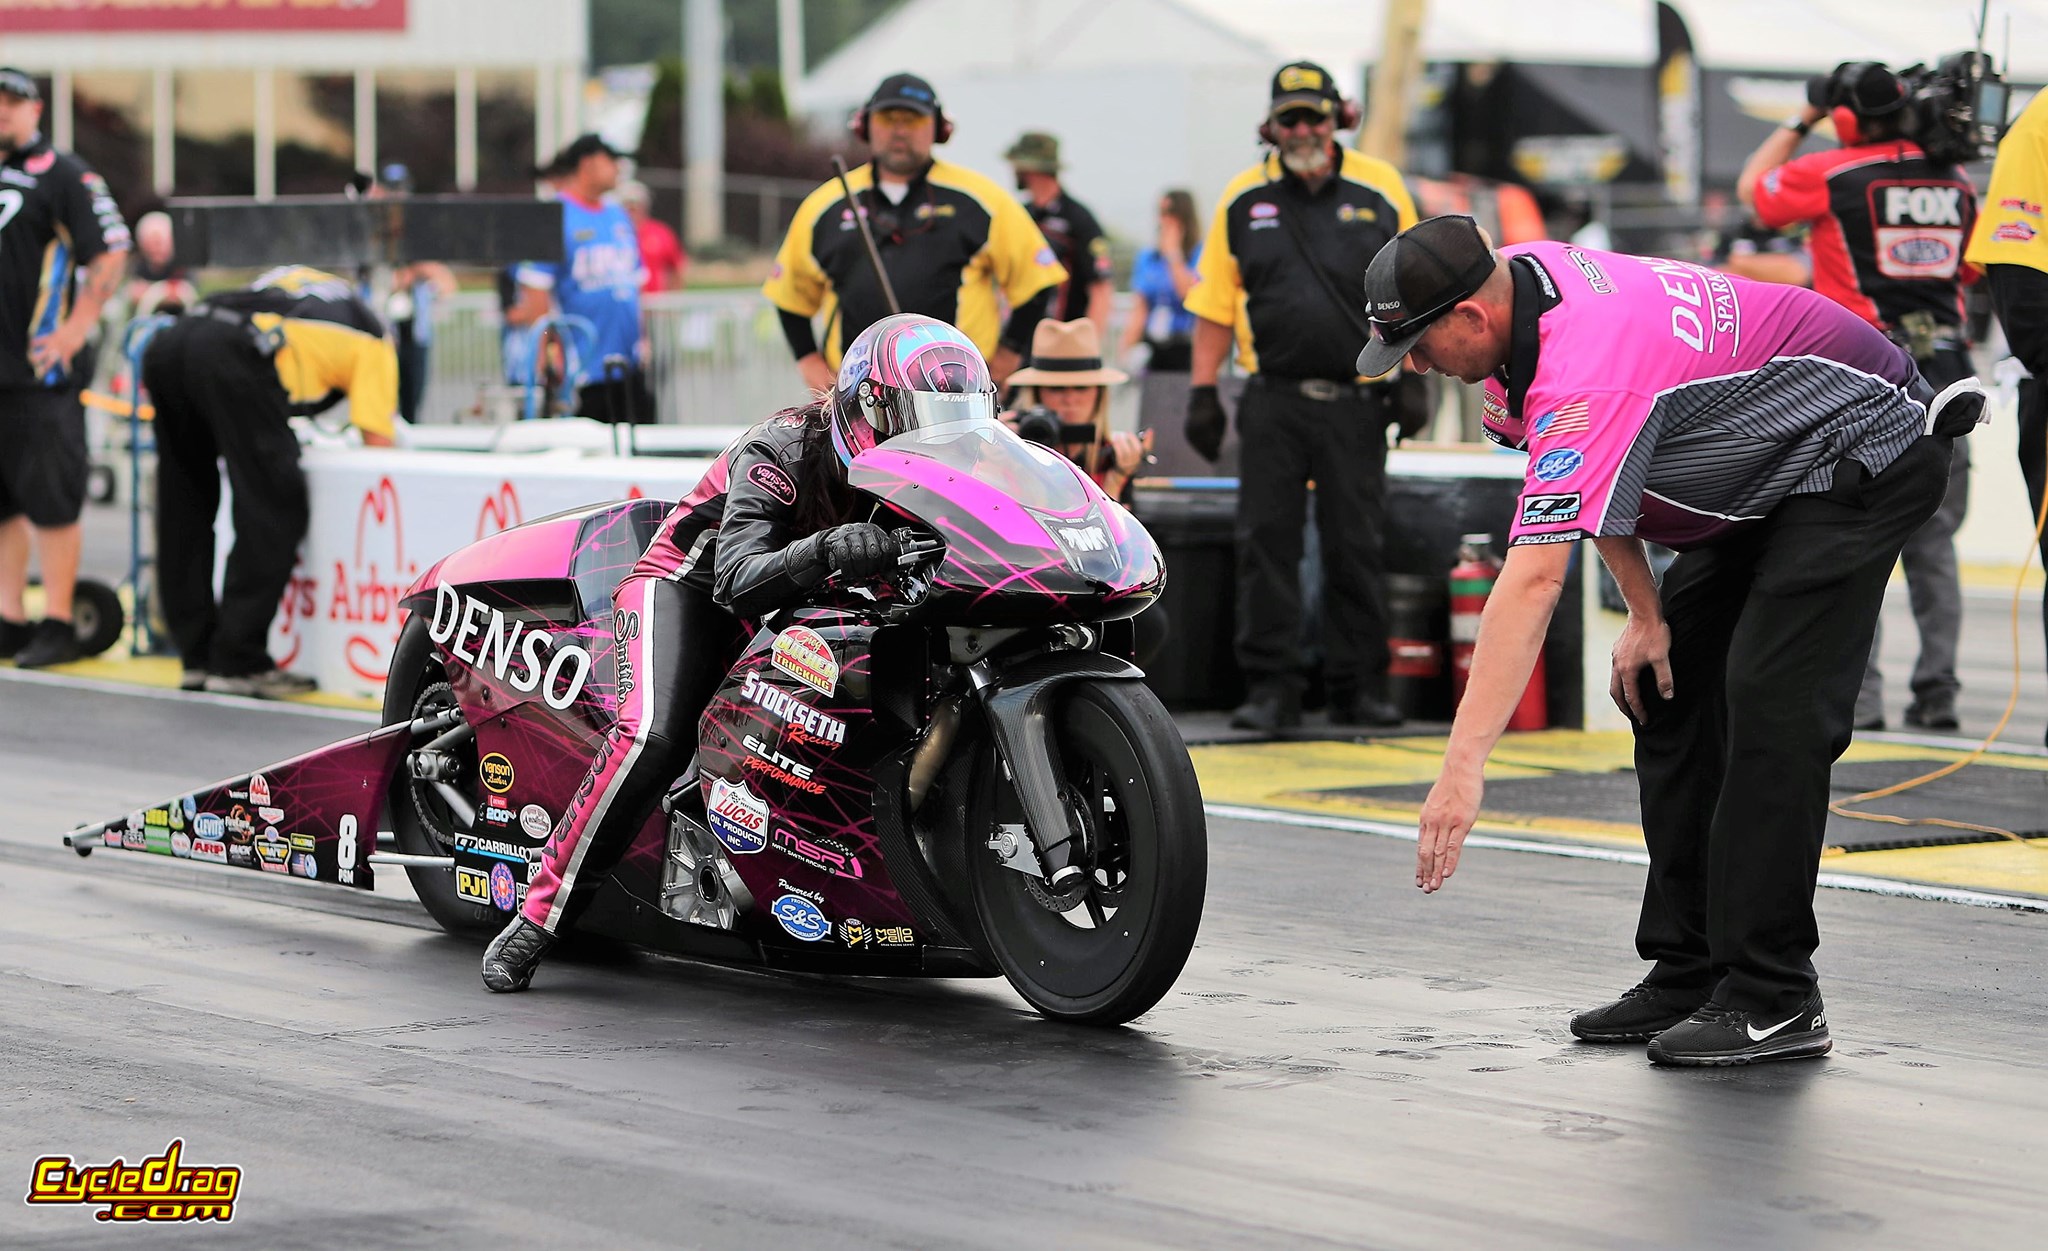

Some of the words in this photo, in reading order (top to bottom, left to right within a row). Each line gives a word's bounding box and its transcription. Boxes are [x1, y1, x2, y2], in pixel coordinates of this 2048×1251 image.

[1885, 186, 1961, 226] FOX
[1377, 300, 1401, 311] DENSO
[1521, 512, 1578, 525] CARRILLO
[428, 579, 592, 710] DENSO
[614, 608, 641, 703] Smith
[775, 651, 831, 690] TRUCKING
[741, 671, 847, 745] STOCKSETH
[787, 722, 843, 751] Racing
[484, 761, 511, 777] vanson
[742, 734, 814, 780] ELITE
[742, 754, 828, 795] PERFORMANCE
[486, 806, 509, 823] 200
[714, 799, 764, 830] LUCAS
[337, 813, 358, 870] 8
[710, 814, 722, 827] OIL
[723, 820, 763, 847] PRODUCTS
[726, 833, 743, 848] INC.
[194, 841, 225, 855] ARP
[477, 837, 532, 863] CARRILLO
[771, 842, 787, 853] MATT
[787, 850, 805, 862] SMITH
[805, 858, 828, 872] RACING
[774, 828, 846, 870] MSR
[337, 868, 355, 885] PSM
[459, 872, 488, 899] PJ1
[778, 878, 814, 900] Powered
[813, 892, 825, 904] by
[779, 904, 822, 931] S&S
[784, 923, 820, 938] PERFORMANCE
[1810, 1011, 1826, 1031] AI
